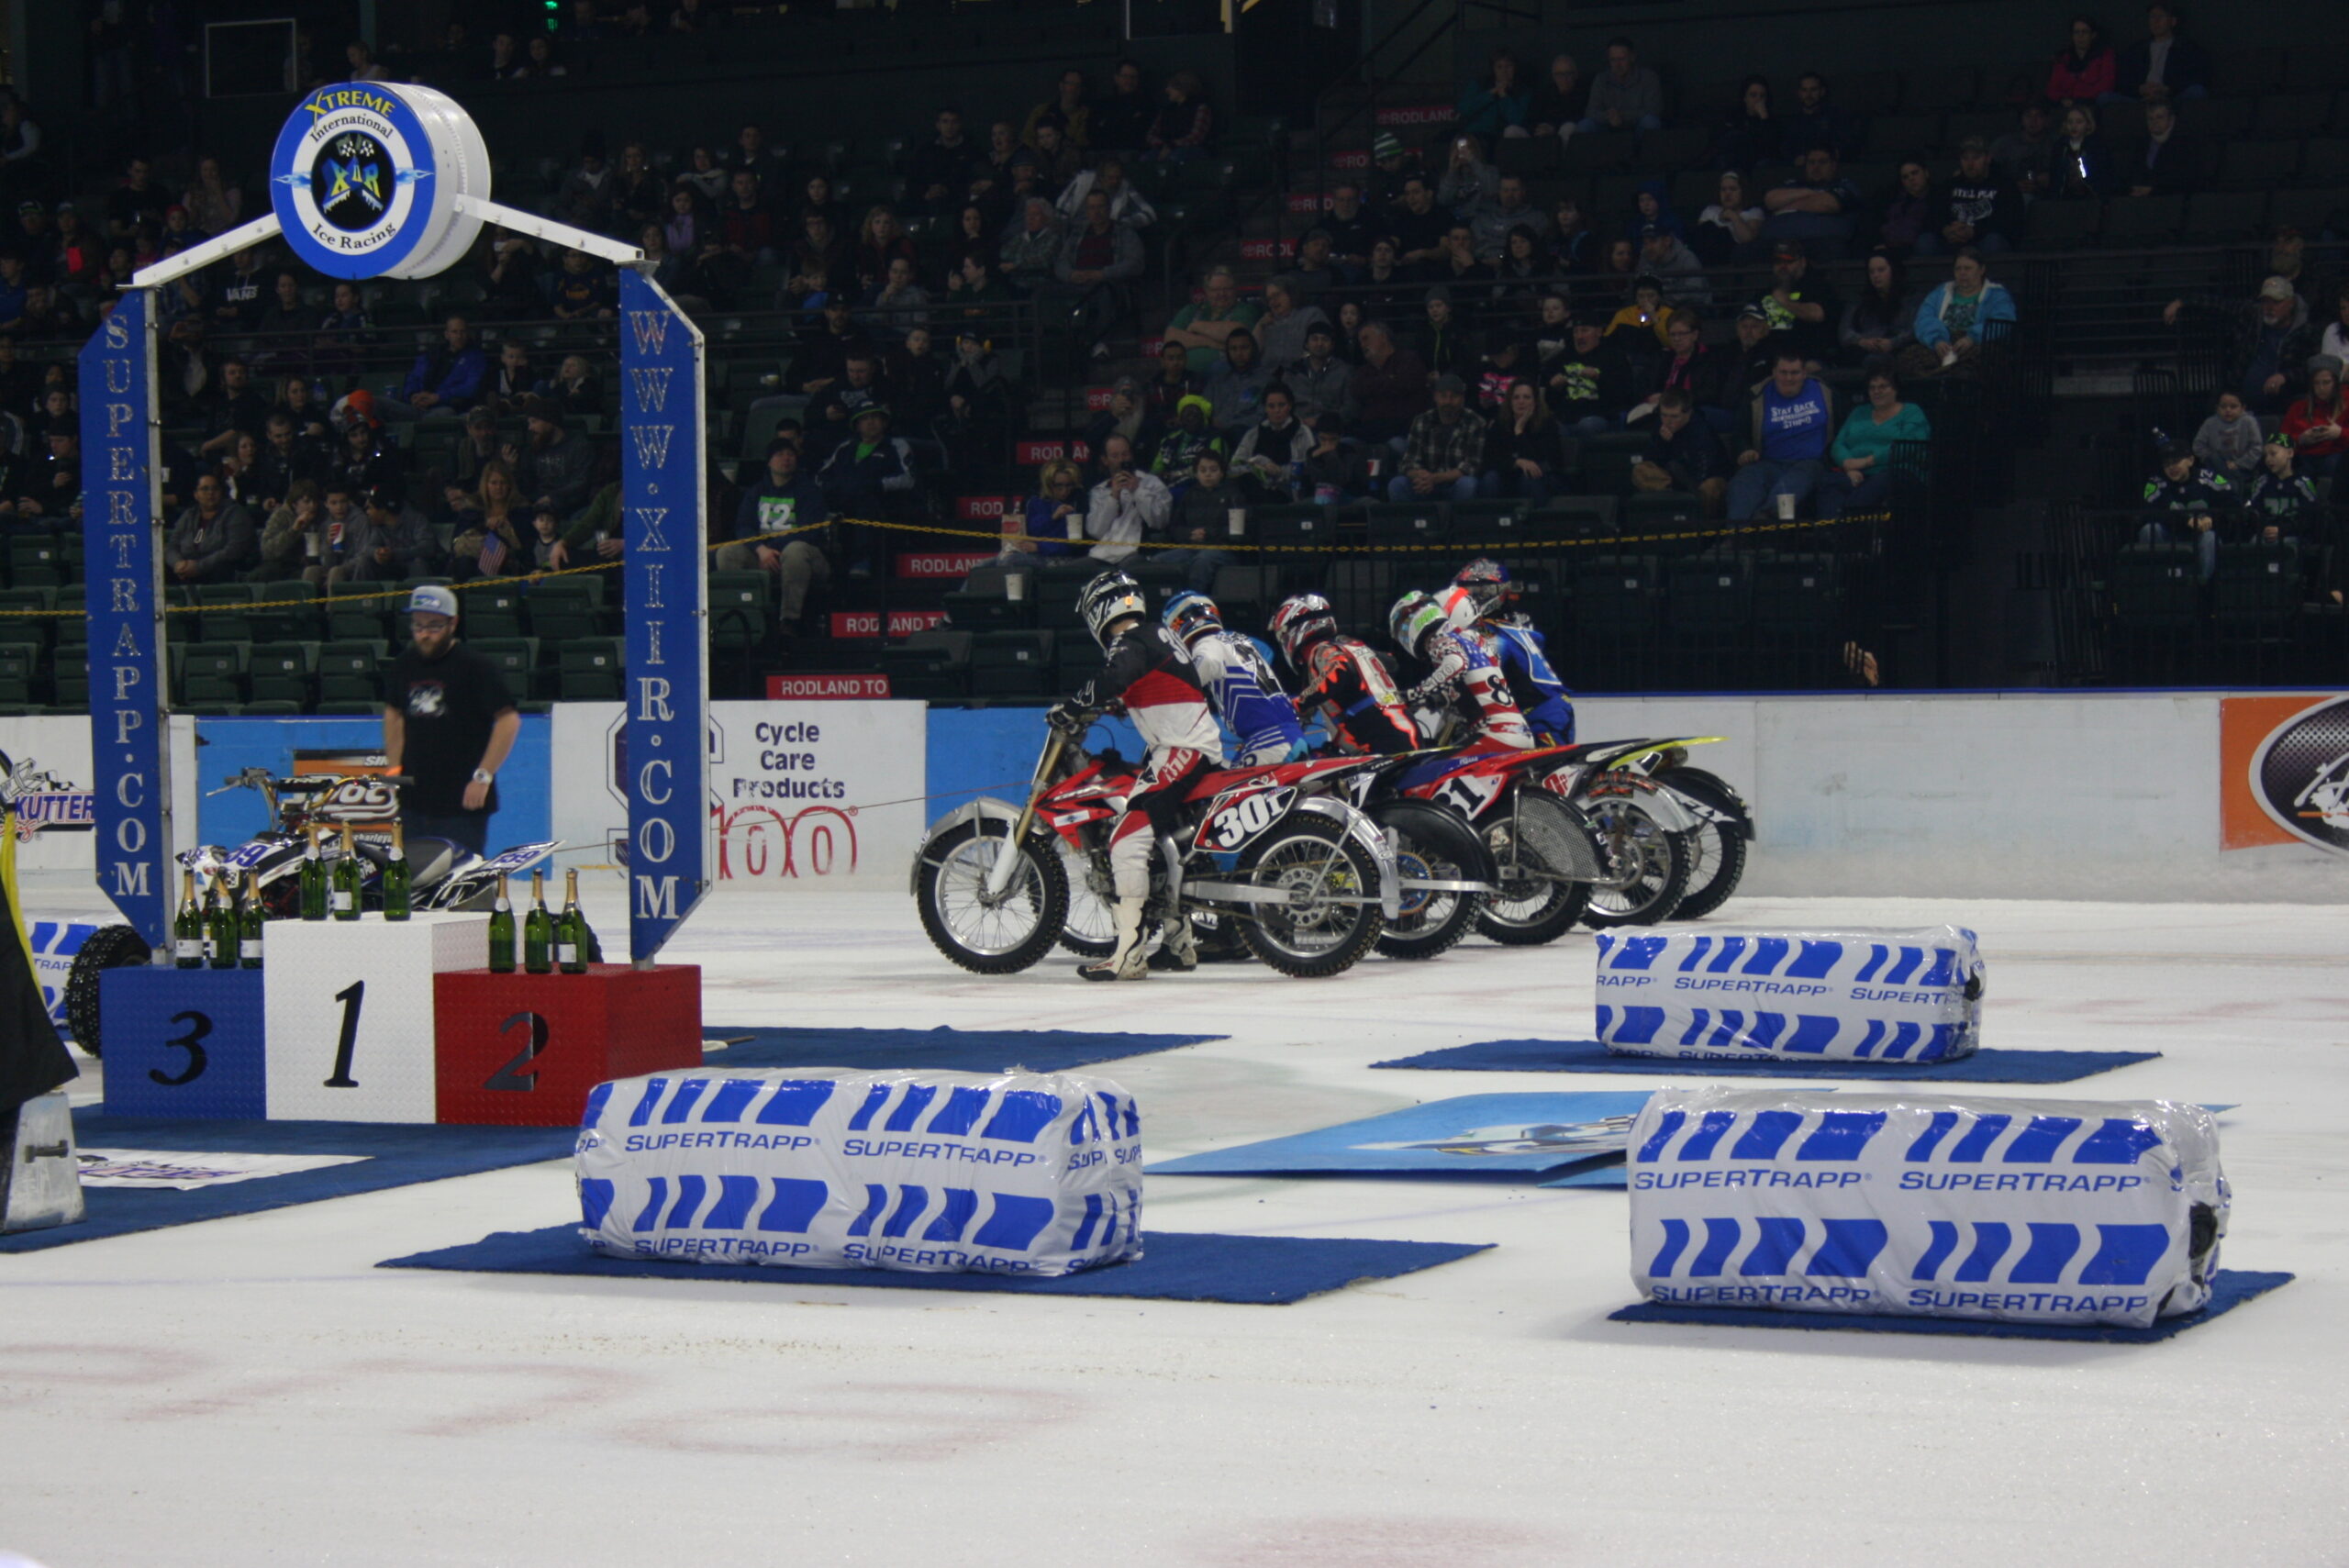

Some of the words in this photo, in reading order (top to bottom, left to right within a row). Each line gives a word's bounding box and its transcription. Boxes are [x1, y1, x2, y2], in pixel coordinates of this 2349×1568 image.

[304, 90, 395, 130] XTREME
[310, 113, 394, 142] International
[313, 222, 336, 245] Ice
[340, 222, 395, 250] Racing
[759, 504, 792, 530] 12
[911, 559, 981, 573] RODLAN
[782, 681, 861, 695] RODLAND
[755, 722, 819, 746] Cycle
[761, 751, 815, 771] Care
[733, 778, 845, 798] Products
[15, 795, 94, 821] KUTTER
[1213, 793, 1284, 848] 301
[1674, 976, 1828, 996] SUPERTRAPP
[323, 980, 365, 1087] 1
[149, 1010, 213, 1085] 3
[482, 1012, 549, 1091] 2
[625, 1131, 812, 1152] SUPERTRAPP
[843, 1140, 1036, 1167] SUPERTRAPP
[1634, 1169, 1862, 1190] SUPERTRAPP
[1898, 1172, 2143, 1192] SUPERTRAPP
[634, 1238, 810, 1257] SUPERTRAPP
[1652, 1284, 1871, 1303] SUPERTRAPP
[1908, 1289, 2149, 1313] SUPERTRAPP
